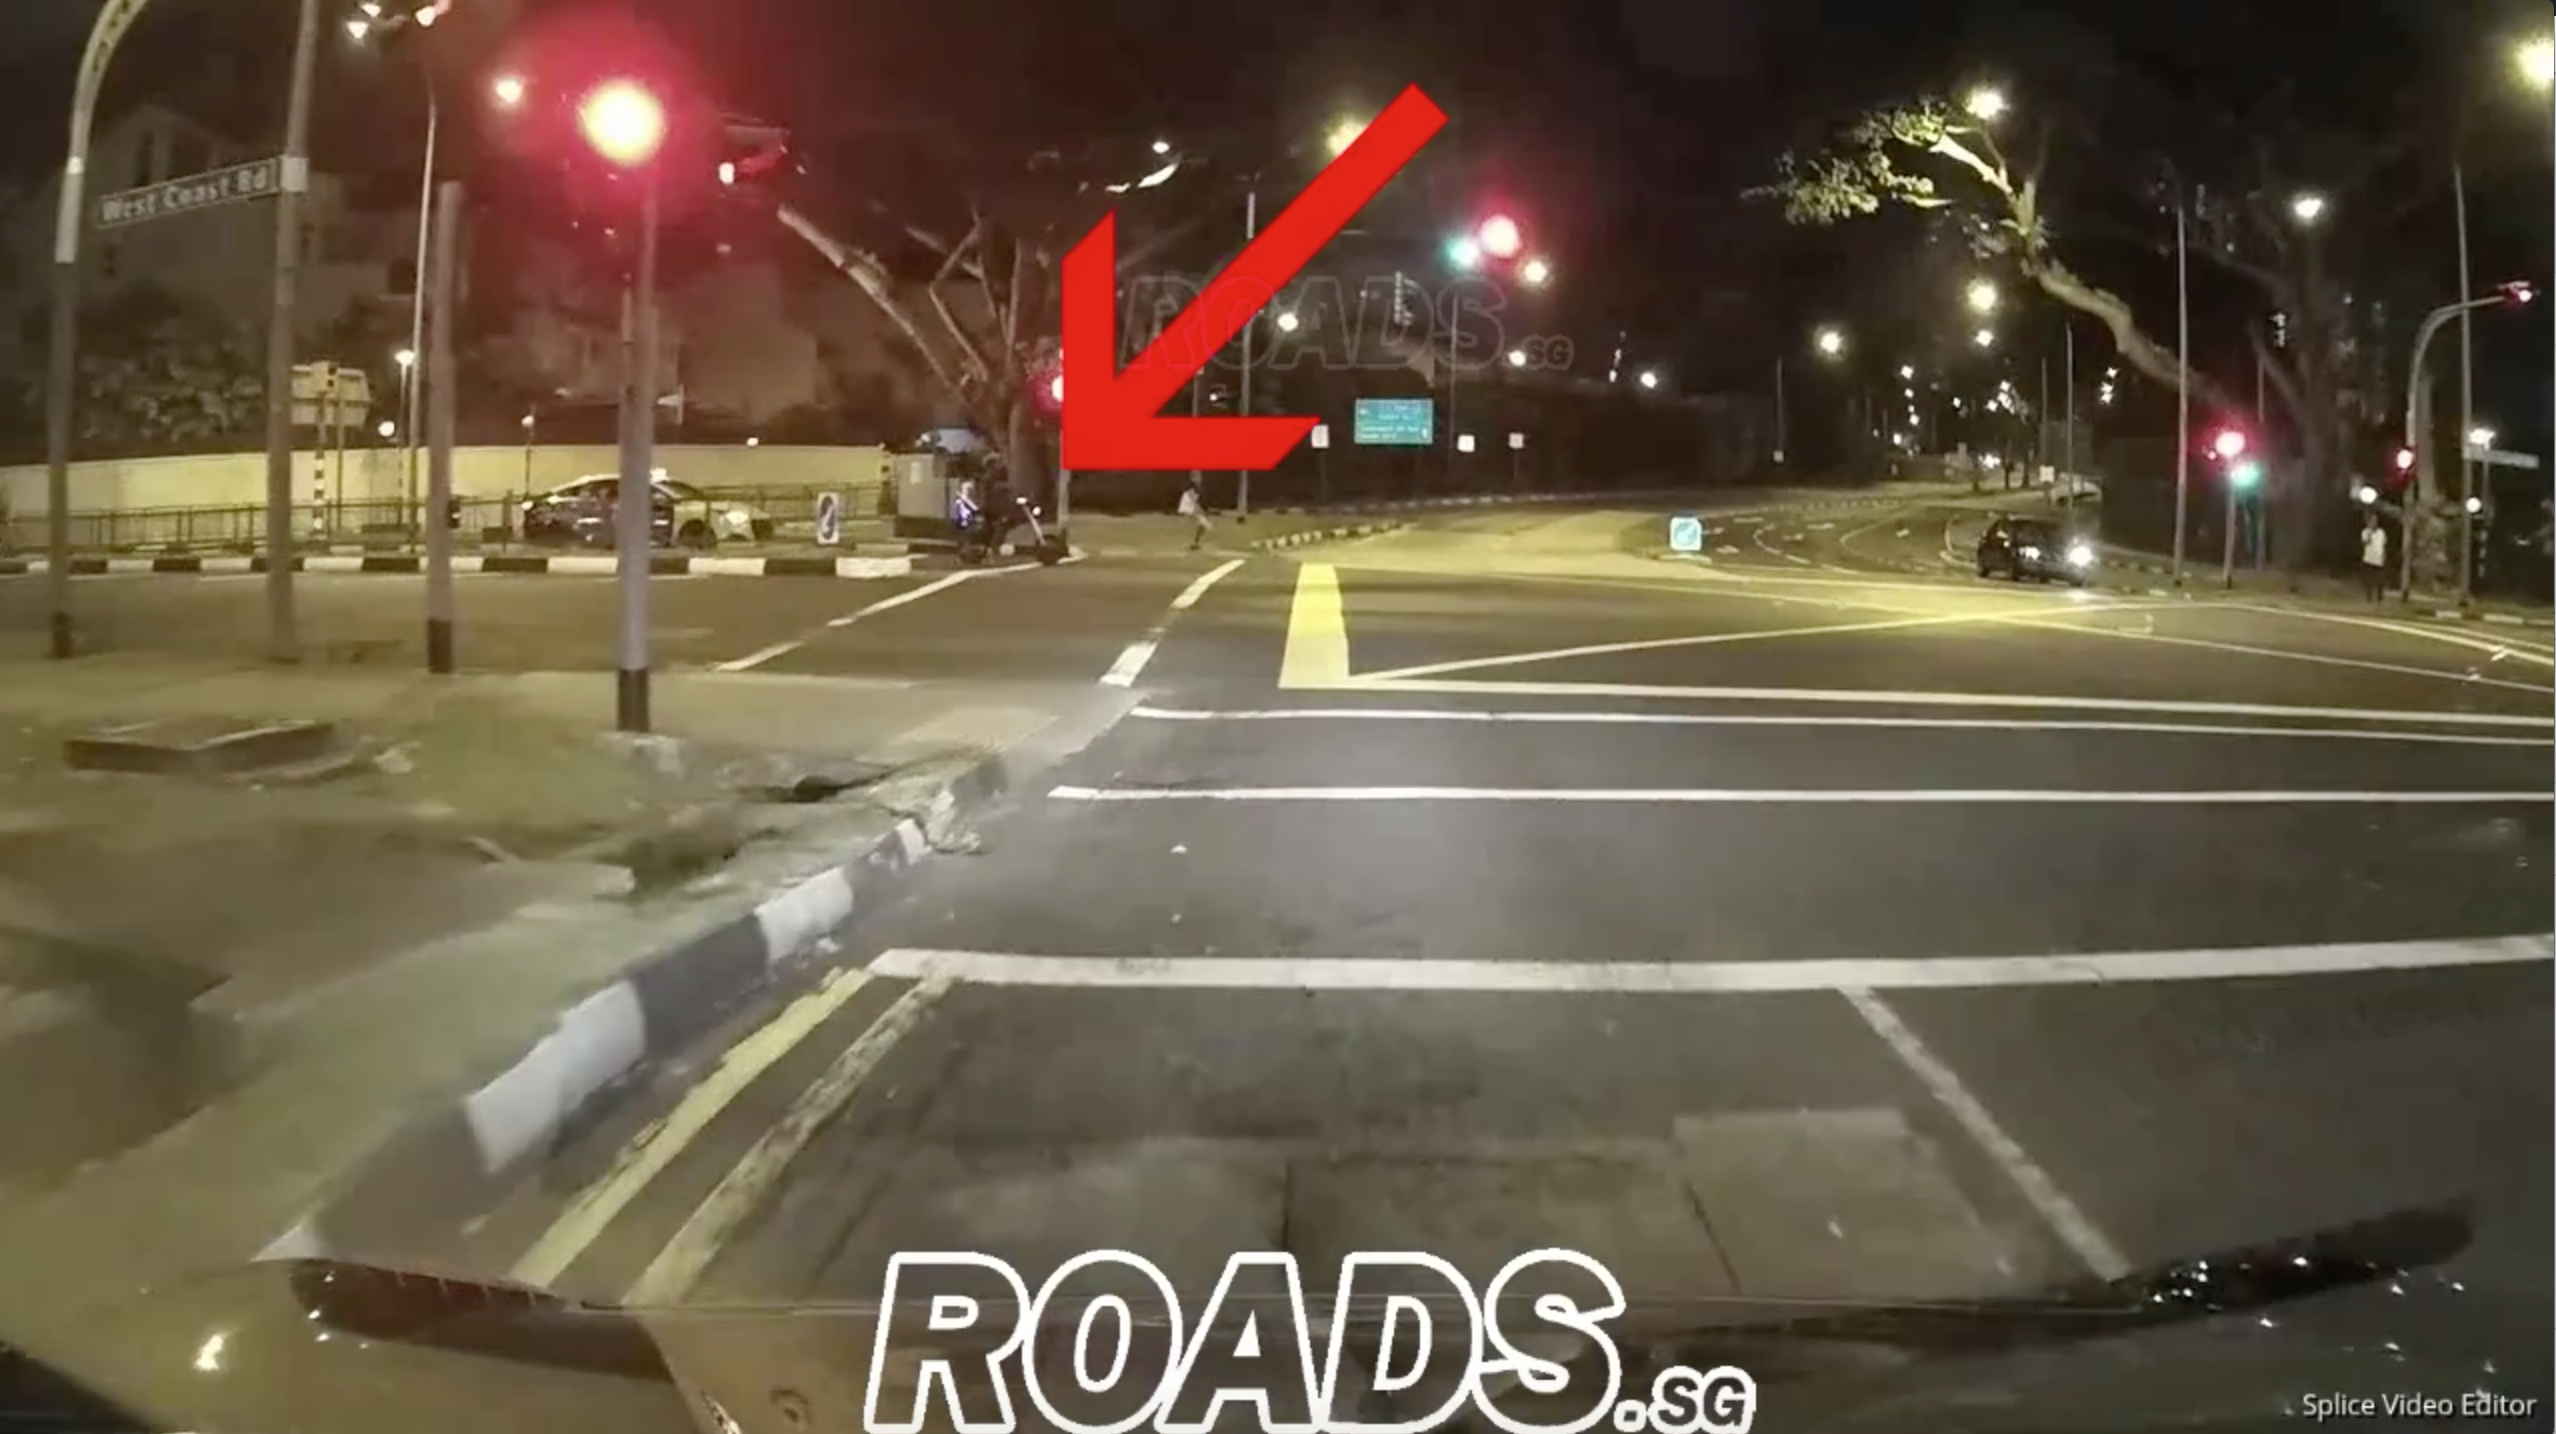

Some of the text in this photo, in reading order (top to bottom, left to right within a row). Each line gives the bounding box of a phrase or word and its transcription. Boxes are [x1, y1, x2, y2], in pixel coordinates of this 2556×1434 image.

[102, 166, 268, 221] West Coast Rd
